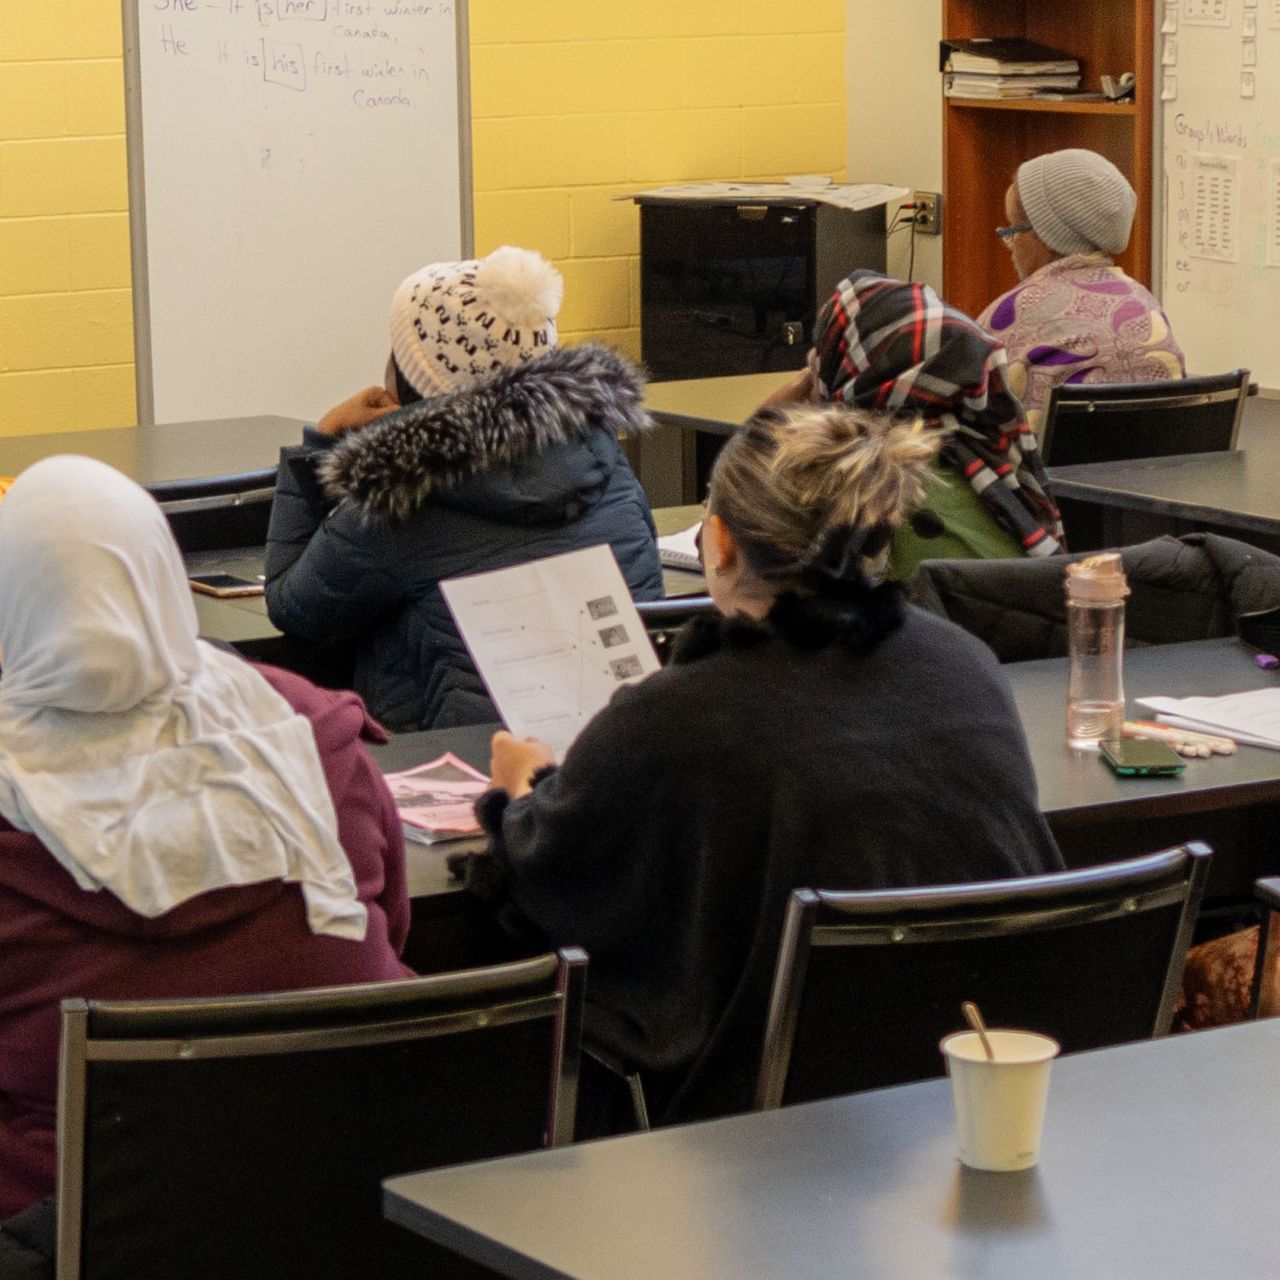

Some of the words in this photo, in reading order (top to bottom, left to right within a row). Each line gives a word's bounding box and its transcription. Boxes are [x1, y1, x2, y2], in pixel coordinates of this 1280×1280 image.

[439, 2, 453, 15] in
[161, 21, 190, 56] He
[244, 50, 260, 66] is
[272, 50, 299, 75] his
[313, 50, 355, 77] first
[1175, 112, 1205, 152] Group
[1216, 121, 1248, 149] Words
[1175, 259, 1191, 272] ee
[1176, 280, 1191, 293] or
